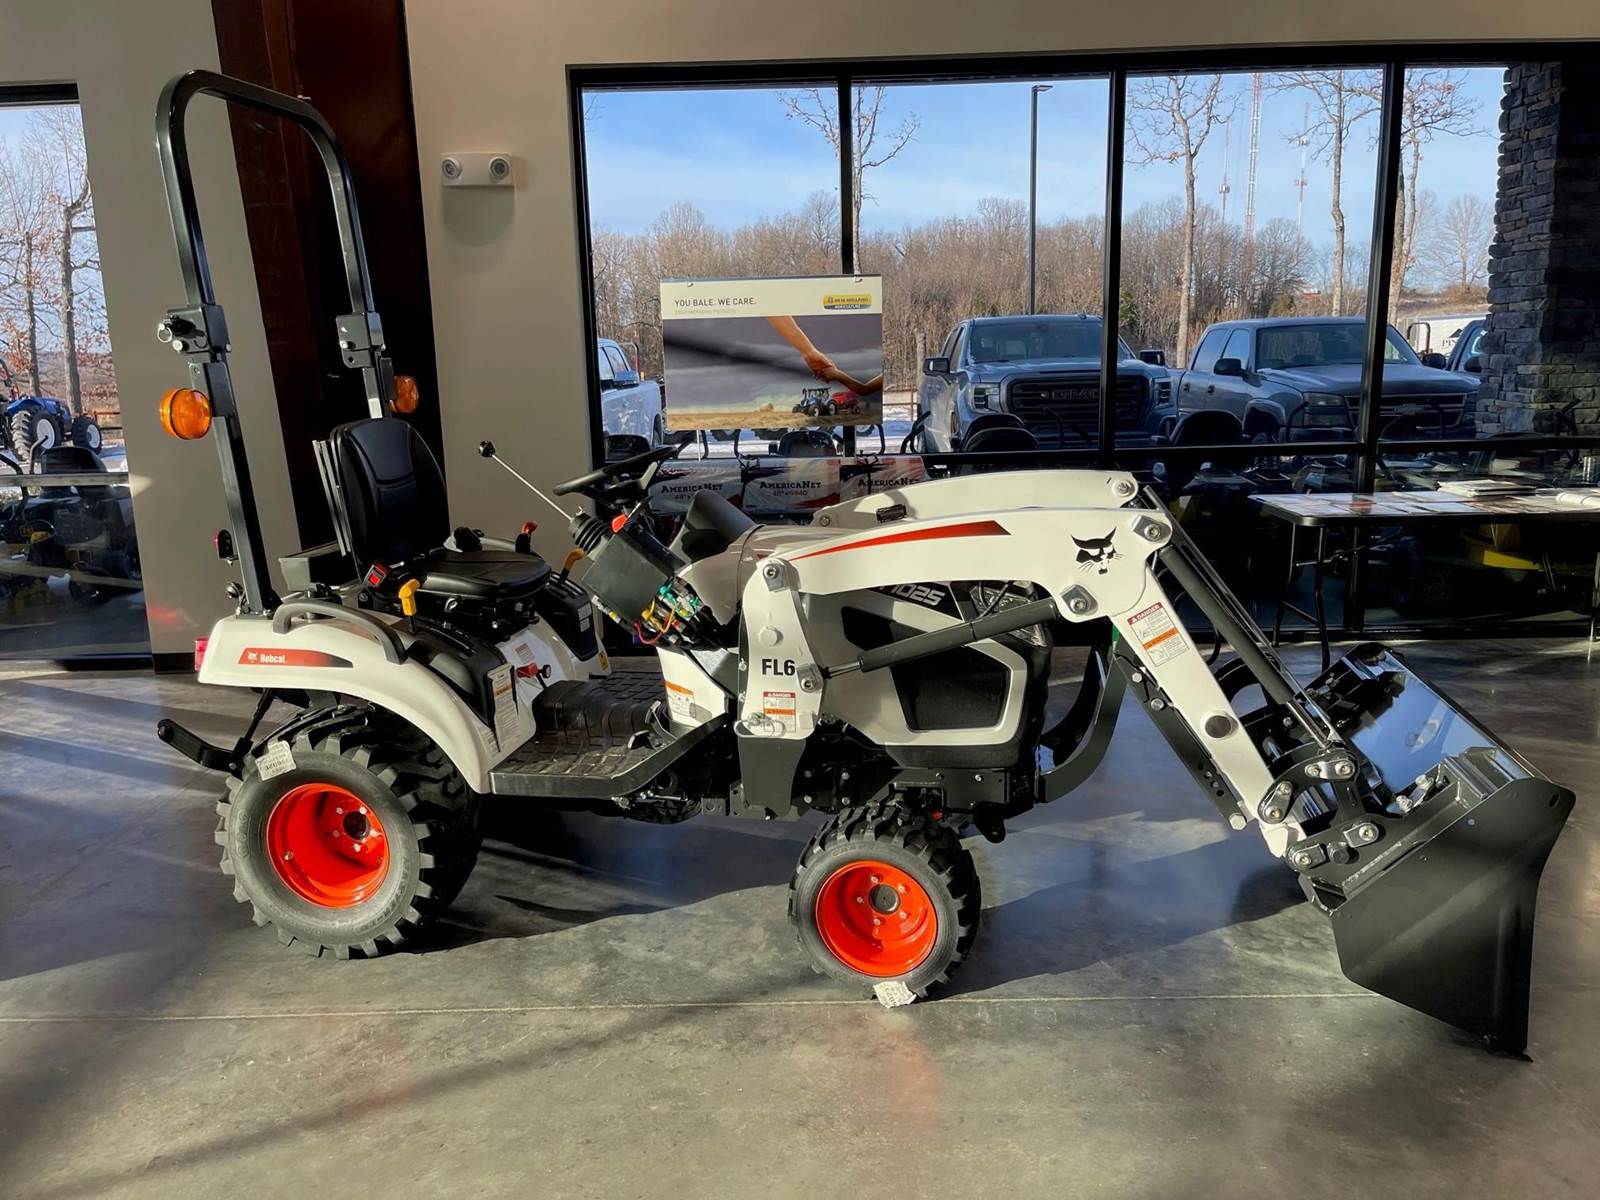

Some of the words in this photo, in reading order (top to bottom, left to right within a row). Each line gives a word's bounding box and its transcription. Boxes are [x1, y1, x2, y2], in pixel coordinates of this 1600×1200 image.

[674, 299, 691, 307] YOU
[692, 298, 716, 306] BALE.
[718, 298, 731, 306] WE
[732, 297, 757, 305] CARE.
[879, 584, 946, 606] 1025
[260, 653, 286, 664] Bobcat
[762, 658, 796, 676] FL6
